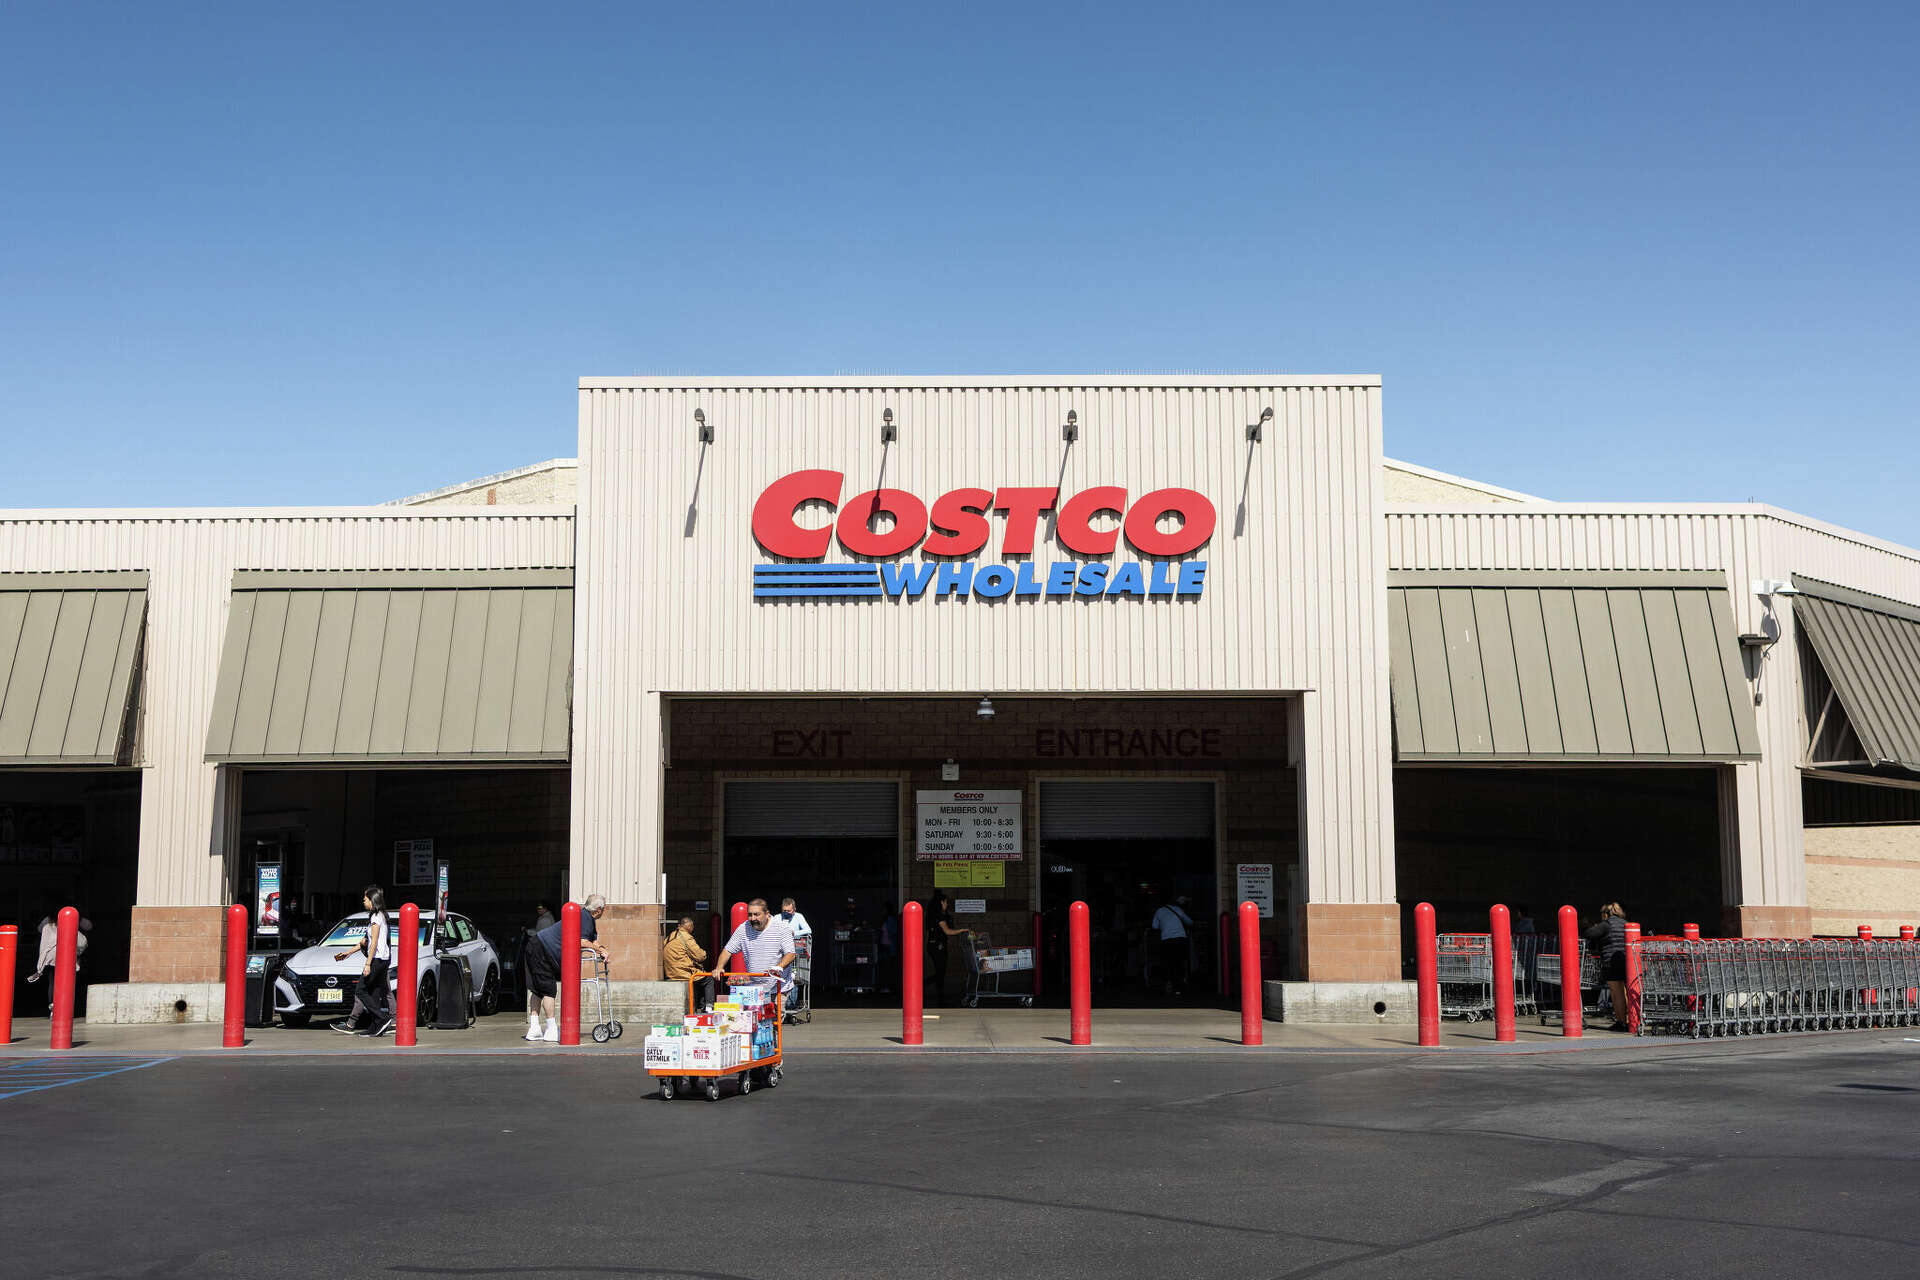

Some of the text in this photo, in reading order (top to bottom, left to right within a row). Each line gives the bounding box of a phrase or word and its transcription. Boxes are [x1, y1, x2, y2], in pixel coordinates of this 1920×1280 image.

[752, 469, 1216, 558] COSTCO
[880, 561, 1206, 597] WHOLESALE
[772, 730, 850, 757] EXIT
[1037, 730, 1221, 758] ENTRANCE
